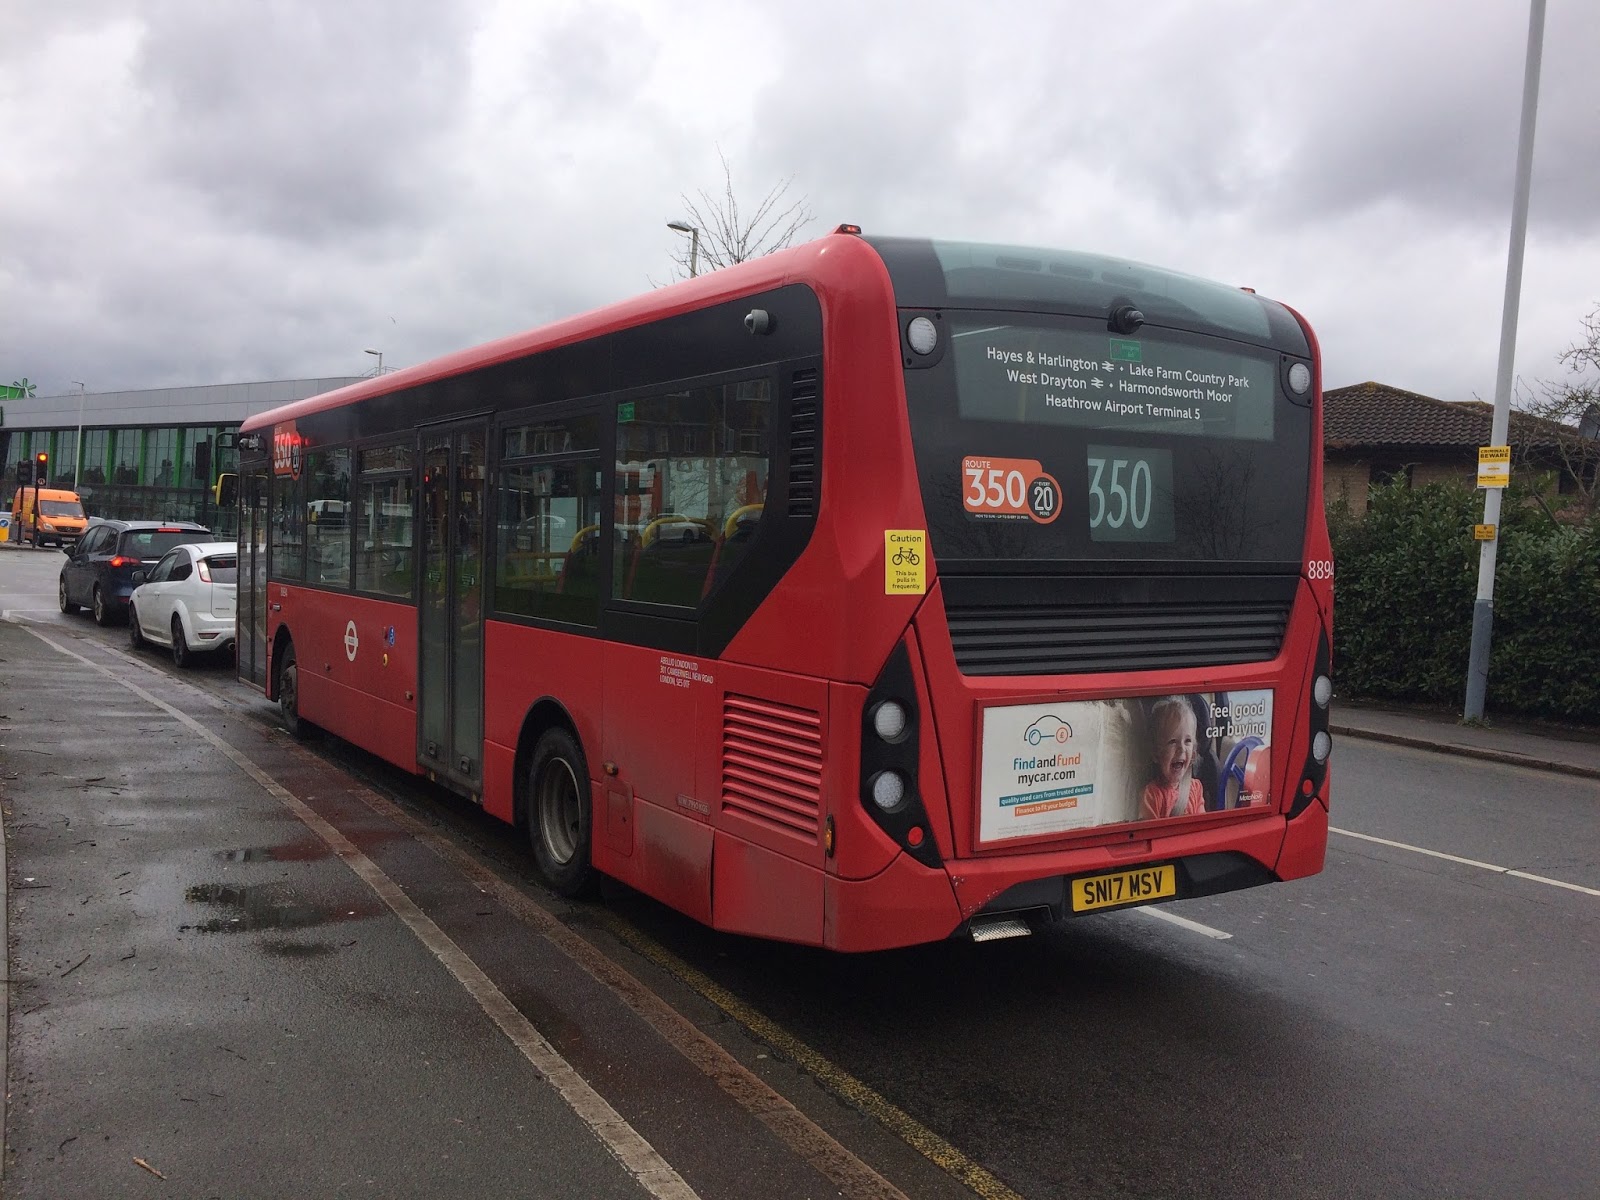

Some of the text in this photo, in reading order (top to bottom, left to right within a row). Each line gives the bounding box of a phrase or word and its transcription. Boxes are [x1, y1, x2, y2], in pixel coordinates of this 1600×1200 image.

[987, 347, 1249, 388] Hayes & Harlington Lake Farm Country Park
[1007, 369, 1232, 403] West Drayton Harmondsworth Moor
[1046, 394, 1201, 420] Heathrow Airport Terminal 5
[965, 460, 991, 469] ROUTE
[966, 469, 1026, 508] 350
[1088, 458, 1152, 529] 350
[1034, 487, 1053, 511] 20
[675, 659, 691, 670] LONDON
[702, 674, 714, 684] ROAD
[1210, 700, 1265, 720] feel good
[1206, 721, 1266, 738] car buying
[1018, 770, 1076, 786] mycar.com
[1001, 796, 1019, 805] quality
[1044, 790, 1056, 798] from
[1057, 788, 1074, 796] trusted
[1059, 800, 1076, 808] budget
[1084, 871, 1162, 904] SN17 MSV
